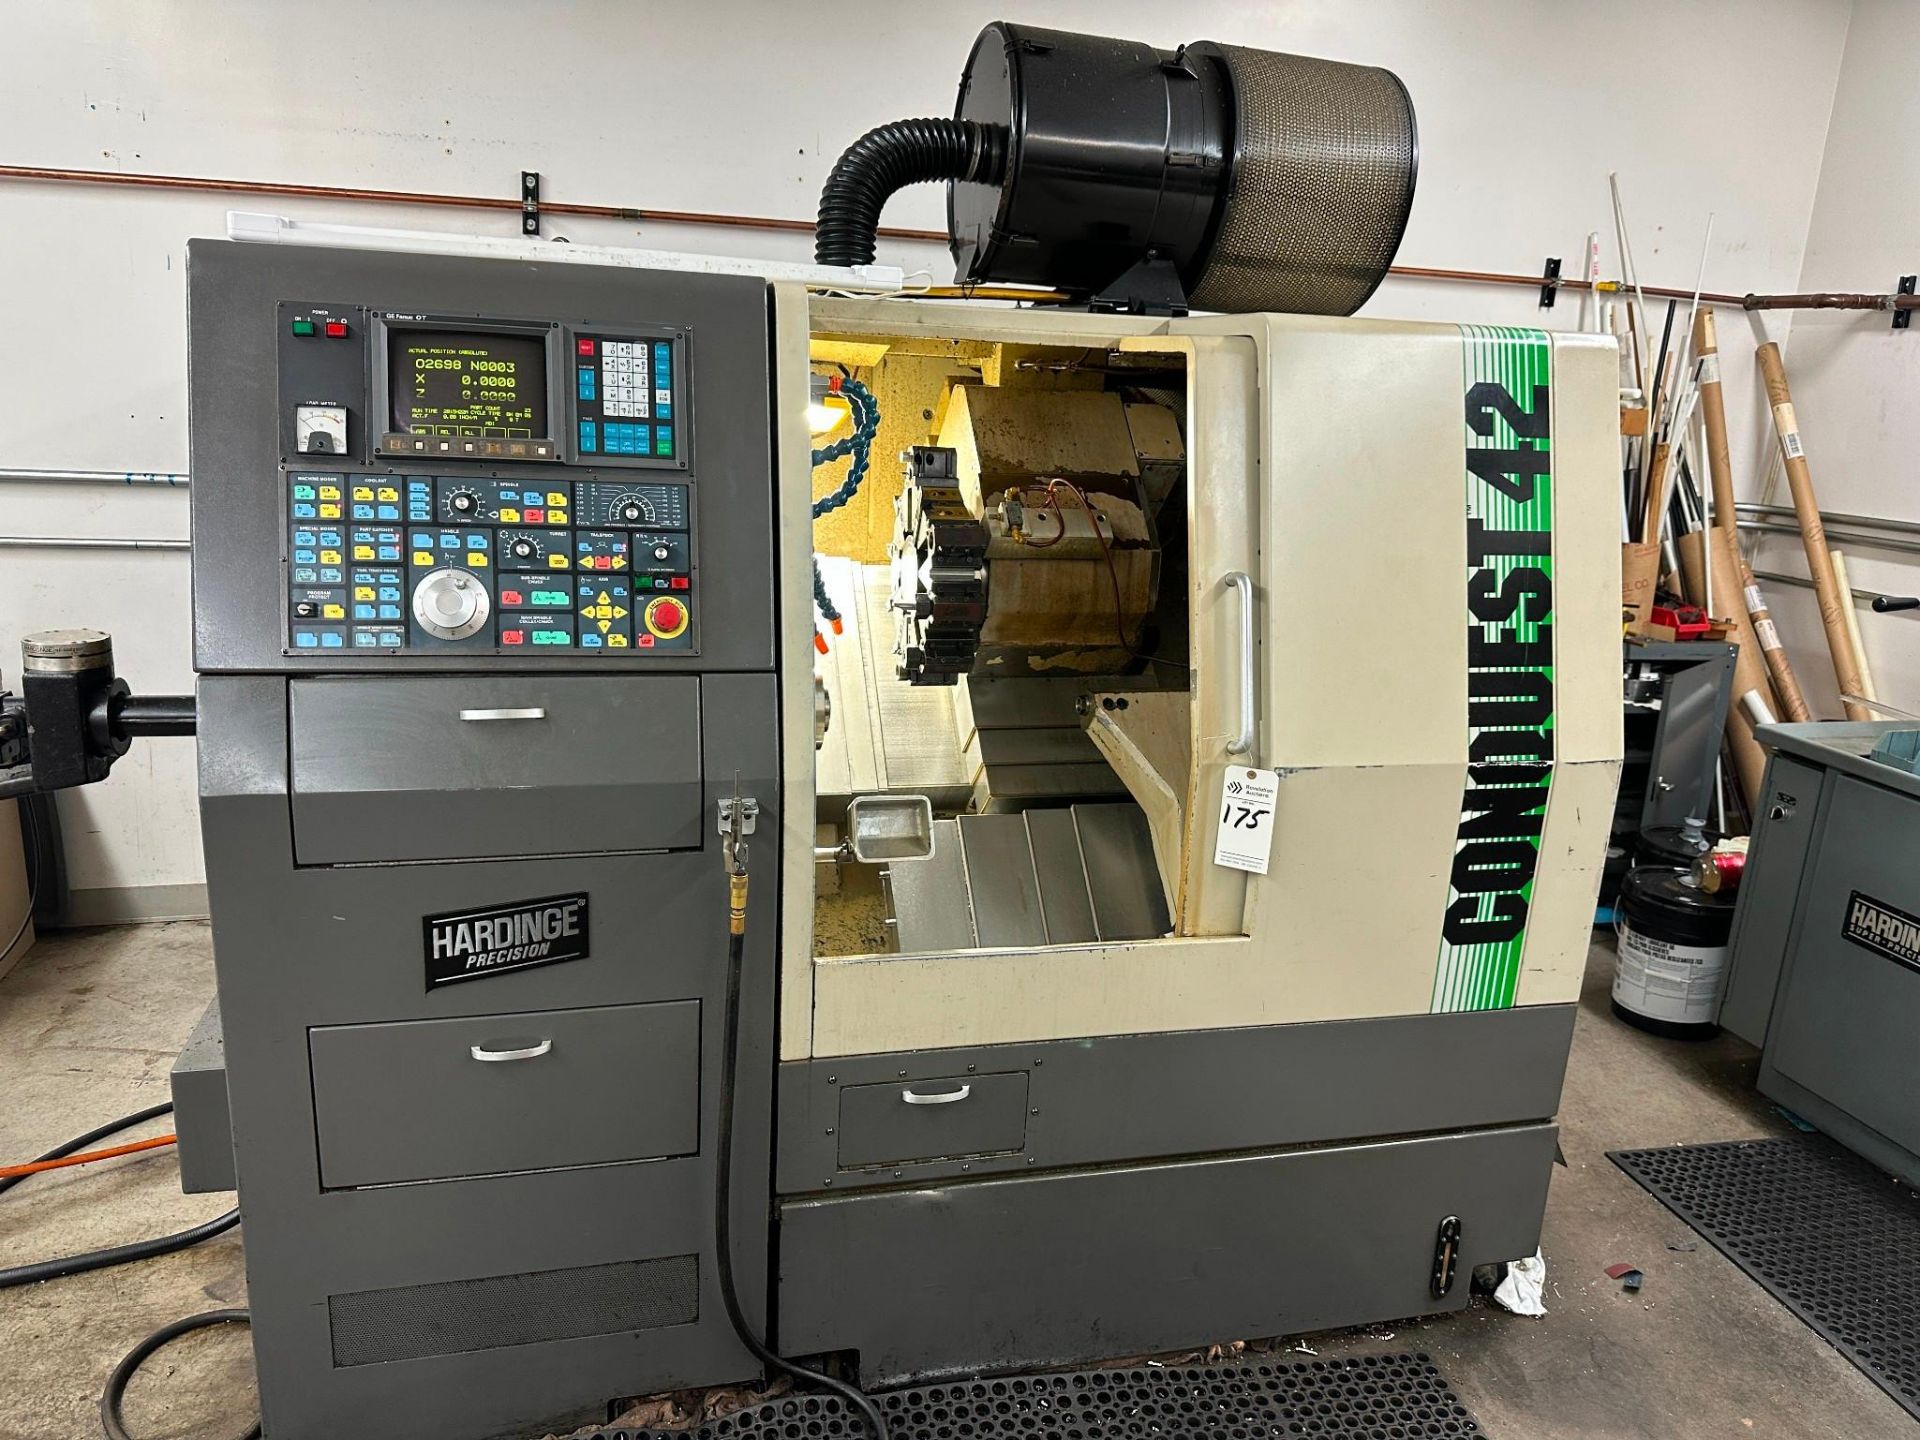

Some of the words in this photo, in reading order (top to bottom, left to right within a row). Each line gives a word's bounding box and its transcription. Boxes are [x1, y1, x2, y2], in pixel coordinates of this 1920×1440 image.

[470, 360, 515, 373] N0003
[415, 373, 425, 384] X
[461, 374, 516, 388] 0.0000
[415, 388, 425, 399] Z
[462, 389, 516, 402] 0.0000
[1465, 382, 1551, 504] 42
[1443, 518, 1553, 945] CONQUEST
[1223, 803, 1270, 829] 175
[432, 904, 580, 959] HARDINGE
[1850, 902, 1920, 953] HARDIN
[466, 942, 550, 968] PRECISION
